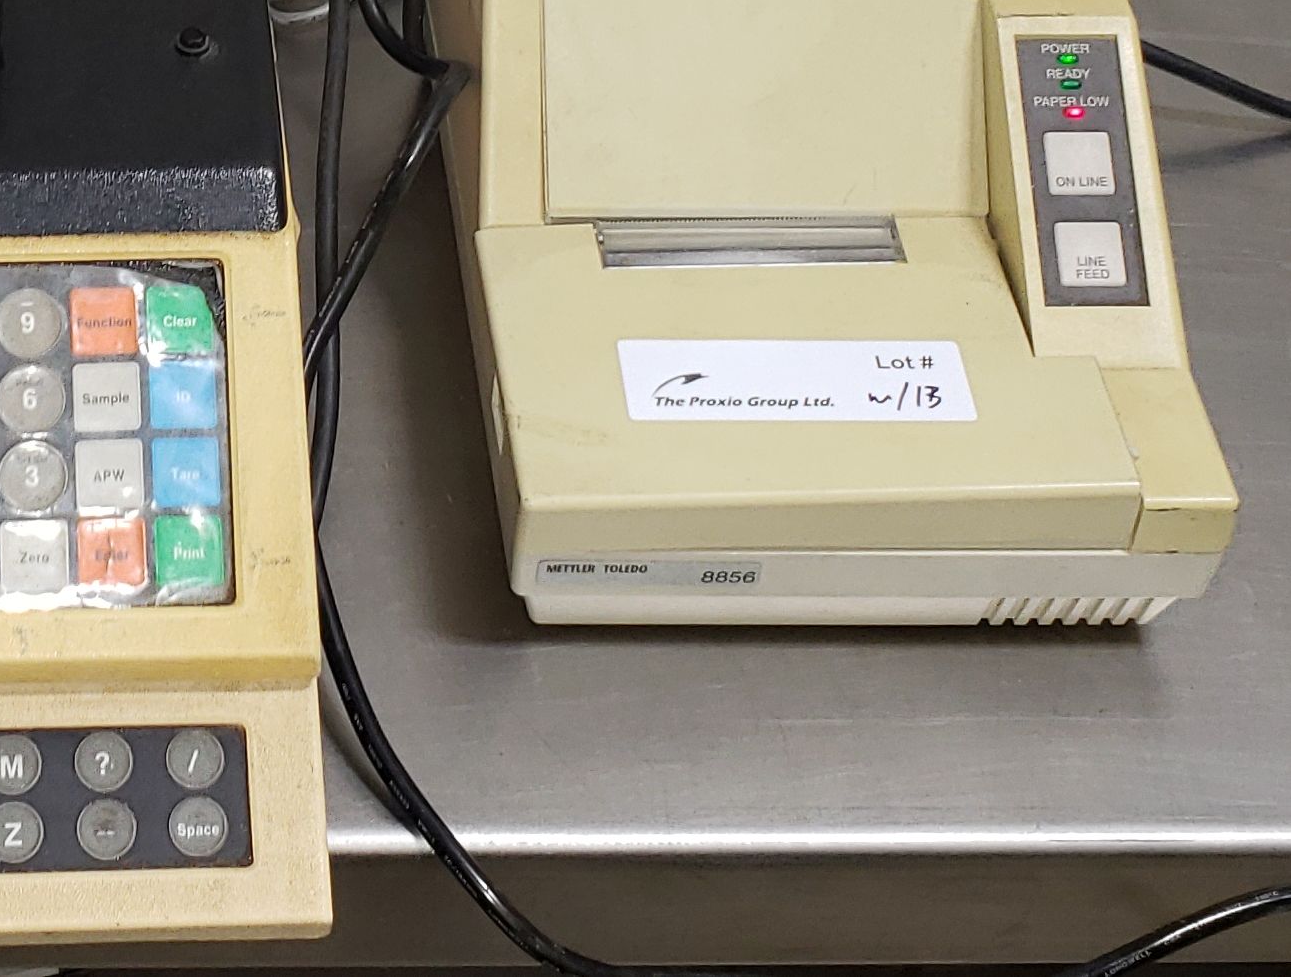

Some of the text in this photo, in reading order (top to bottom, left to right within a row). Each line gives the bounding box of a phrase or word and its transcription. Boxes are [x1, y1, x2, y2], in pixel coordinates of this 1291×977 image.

[1040, 43, 1090, 54] POWER
[1046, 68, 1090, 79] READY
[1033, 96, 1110, 107] PAPER LOW
[1056, 177, 1108, 187] ON LINE
[1077, 256, 1107, 266] LINE
[1076, 269, 1110, 279] FEED
[20, 312, 35, 334] 9
[77, 317, 132, 328] Function
[163, 314, 197, 328] Clear
[875, 354, 934, 370] Lot #
[22, 387, 37, 410] 6
[82, 391, 130, 406] Sample
[654, 395, 835, 410] The Proxio Group Ltd.
[25, 465, 39, 488] 3
[93, 470, 126, 482] APW
[170, 468, 200, 480] Tare
[19, 550, 50, 564] Zero
[173, 545, 206, 560] Print
[546, 564, 648, 574] METTLER TOLEDO
[700, 570, 757, 584] 8856
[0, 755, 23, 779] M
[95, 752, 111, 776] ?
[4, 822, 23, 847] Z
[176, 821, 221, 839] Space
